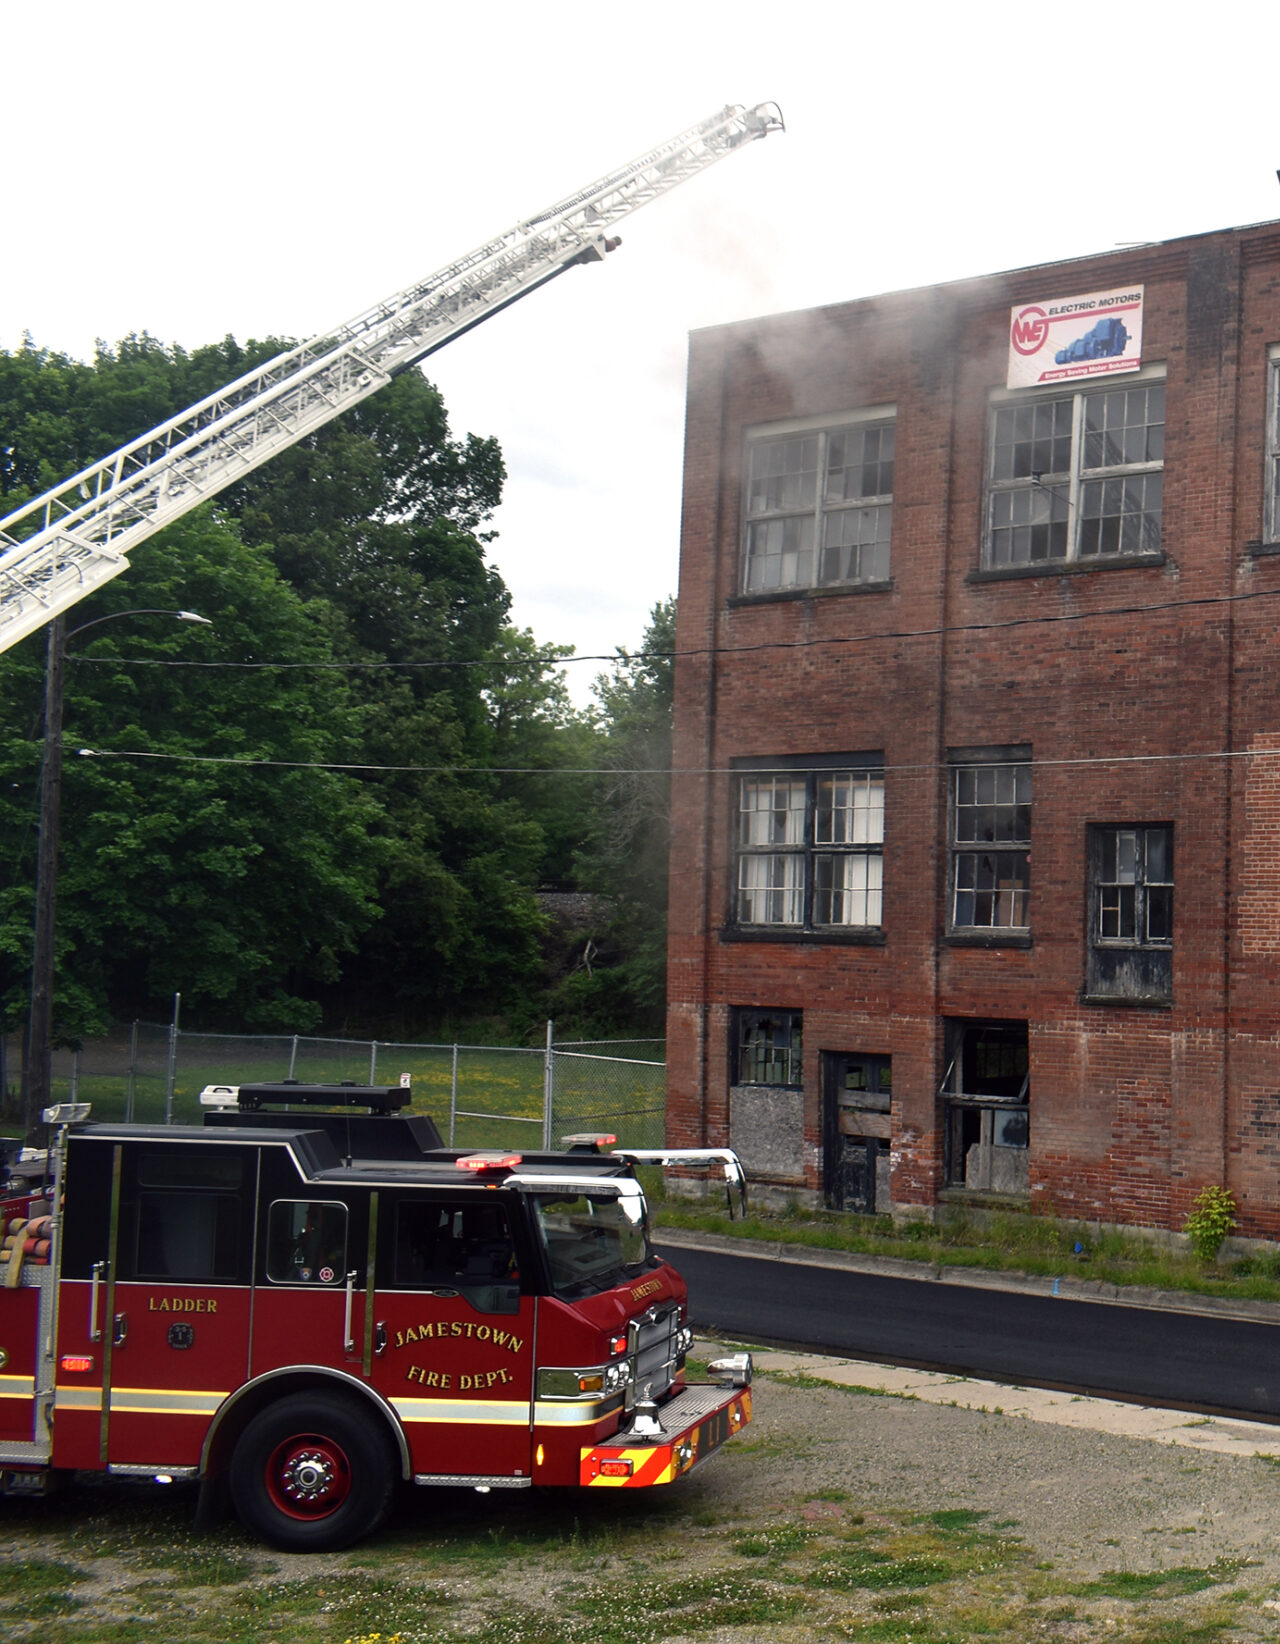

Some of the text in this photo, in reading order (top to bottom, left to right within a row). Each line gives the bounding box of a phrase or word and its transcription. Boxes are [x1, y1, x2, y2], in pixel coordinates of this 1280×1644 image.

[1049, 293, 1141, 315] ELECTRIC MOTORS
[1045, 360, 1137, 379] Energy Saving Motor Solutions
[149, 1297, 217, 1313] LADDER
[394, 1322, 523, 1353] JAMESTOWN
[407, 1365, 513, 1390] FIRE DEPT.
